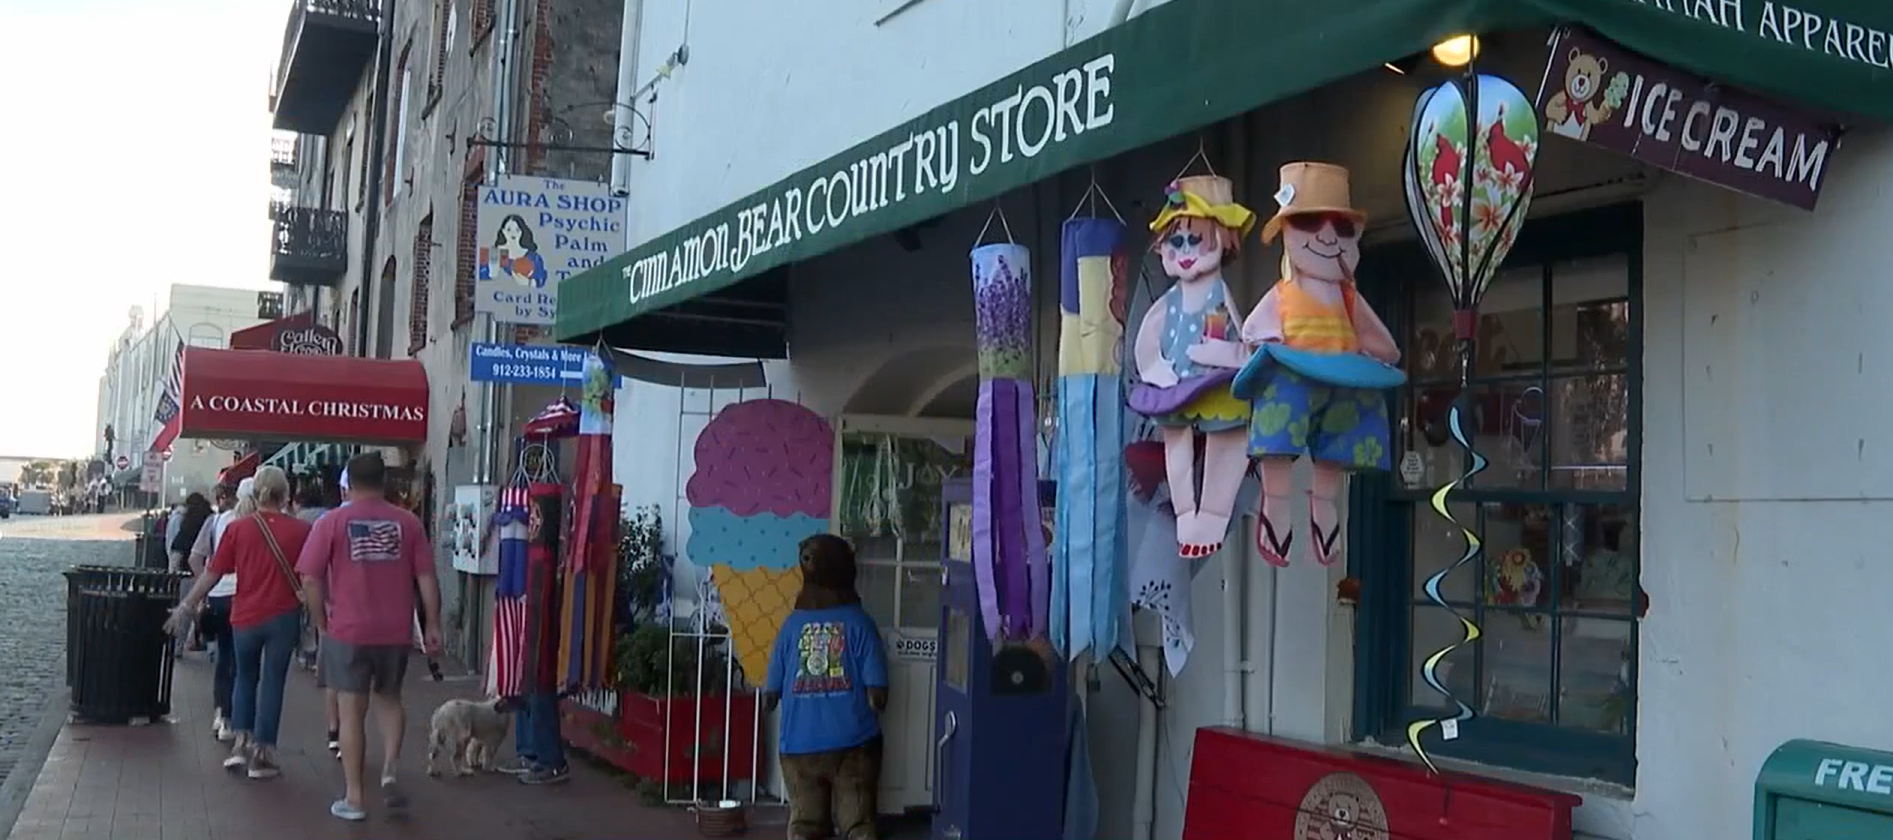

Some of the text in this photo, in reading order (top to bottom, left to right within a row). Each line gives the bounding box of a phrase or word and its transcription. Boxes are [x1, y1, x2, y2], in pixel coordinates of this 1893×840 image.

[1759, 1, 1893, 69] APPARE
[1623, 74, 1828, 192] ICE CREAM
[543, 179, 566, 191] The
[630, 222, 728, 304] CINNAMON
[730, 187, 802, 273] BEAR
[806, 120, 958, 234] COUNTRY
[970, 53, 1115, 176] STORE
[484, 189, 622, 213] AURA SHOP
[538, 212, 621, 233] Psychic
[555, 234, 608, 252] Palm
[493, 290, 532, 303] Card
[515, 305, 532, 318] by
[515, 347, 550, 361] Crystals
[190, 395, 424, 421] A COASTAL CHRISTMAS
[906, 640, 936, 651] DOGS
